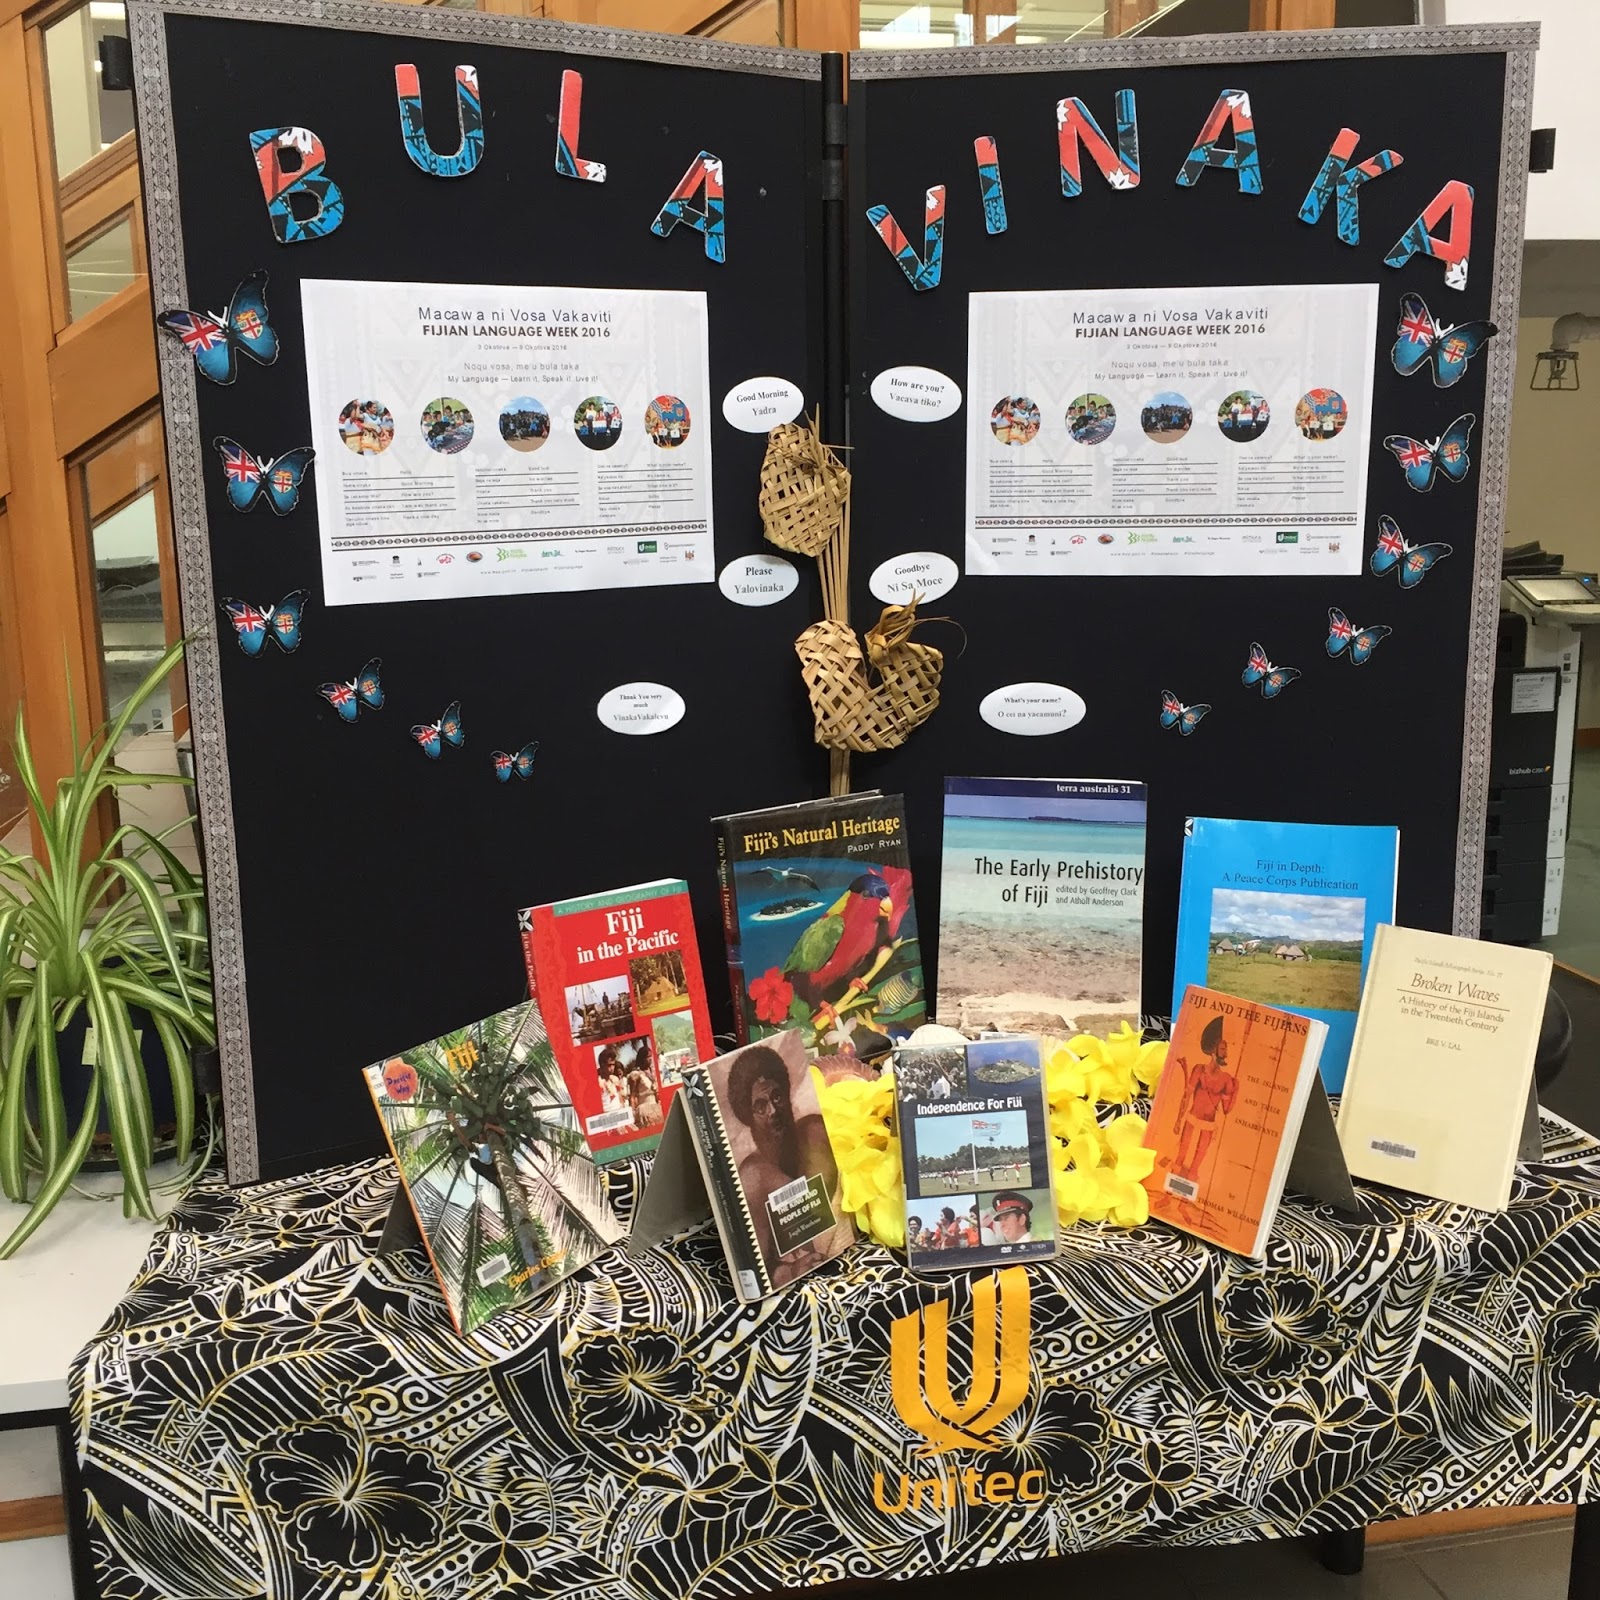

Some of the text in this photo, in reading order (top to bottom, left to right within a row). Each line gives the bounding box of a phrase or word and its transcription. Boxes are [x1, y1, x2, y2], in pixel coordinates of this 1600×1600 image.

[249, 64, 726, 263] BULA
[866, 89, 1476, 291] VINAKA
[491, 309, 505, 321] ni
[510, 308, 546, 322] Vosa
[552, 309, 612, 323] Vakaviti
[1143, 311, 1156, 323] ni
[1163, 310, 1198, 322] Vosa
[1205, 308, 1268, 321] Vakaviti
[423, 324, 610, 338] FIJIAN LANGUAGE WEEK 2016
[1075, 323, 1266, 338] FIJIAN LANGUAGE WEEK 2016
[540, 362, 558, 371] bula
[561, 363, 579, 371] taka
[1187, 359, 1206, 367] bula
[1209, 358, 1229, 367] taka
[447, 375, 459, 383] My
[462, 375, 499, 384] Language
[510, 375, 531, 383] Learn
[542, 375, 564, 383] Speak
[1095, 373, 1106, 381] My
[1108, 372, 1145, 381] Language
[1188, 371, 1211, 379] Speak
[890, 377, 945, 394] How are you?
[736, 389, 789, 403] Good Morning
[889, 391, 942, 408] Vacava tiko?
[752, 406, 777, 417] Yadra
[745, 566, 773, 577] Please
[894, 563, 931, 577] Goodbye
[734, 583, 784, 595] Yalovinaka
[887, 576, 943, 594] Ni Sa Moce
[1509, 767, 1532, 775] bizhub
[1056, 784, 1131, 794] terra australis 31
[744, 816, 900, 855] Fiji's Natural Heritage
[847, 839, 901, 854] PADDY RYAN
[720, 859, 729, 891] Natural
[974, 856, 1144, 886] The Early Prehistory
[1256, 859, 1325, 875] Fiji in Depth:
[1222, 873, 1358, 890] A Peace Corps Publication
[1002, 884, 1049, 908] of Fiji
[1056, 885, 1138, 896] edited by Geoffrey Clark
[566, 902, 594, 912] HISTORY
[1092, 898, 1124, 906] Anderson
[724, 892, 732, 930] Heritage
[605, 907, 645, 936] Fiji
[576, 928, 680, 964] in the Pacific
[1411, 973, 1501, 1003] Broken Waves
[1189, 994, 1308, 1036] FIJI AND THE FIJIANS
[1399, 995, 1504, 1023] A History of the Fiji Islands
[1410, 1007, 1423, 1017] the
[1425, 1010, 1464, 1025] Twentieth
[1465, 1019, 1498, 1033] Century
[445, 1041, 479, 1072] Fiji
[1247, 1075, 1289, 1093] THE ISLANDS
[917, 1096, 1023, 1116] Independence For Fiji
[1244, 1098, 1258, 1107] AND
[804, 1189, 818, 1201] AND
[779, 1198, 821, 1226] PEOPLE OF FIJI
[1197, 1197, 1260, 1227] THOMAS WILLIAMS
[508, 1264, 540, 1289] Charles
[873, 1465, 1045, 1515] Unitec
